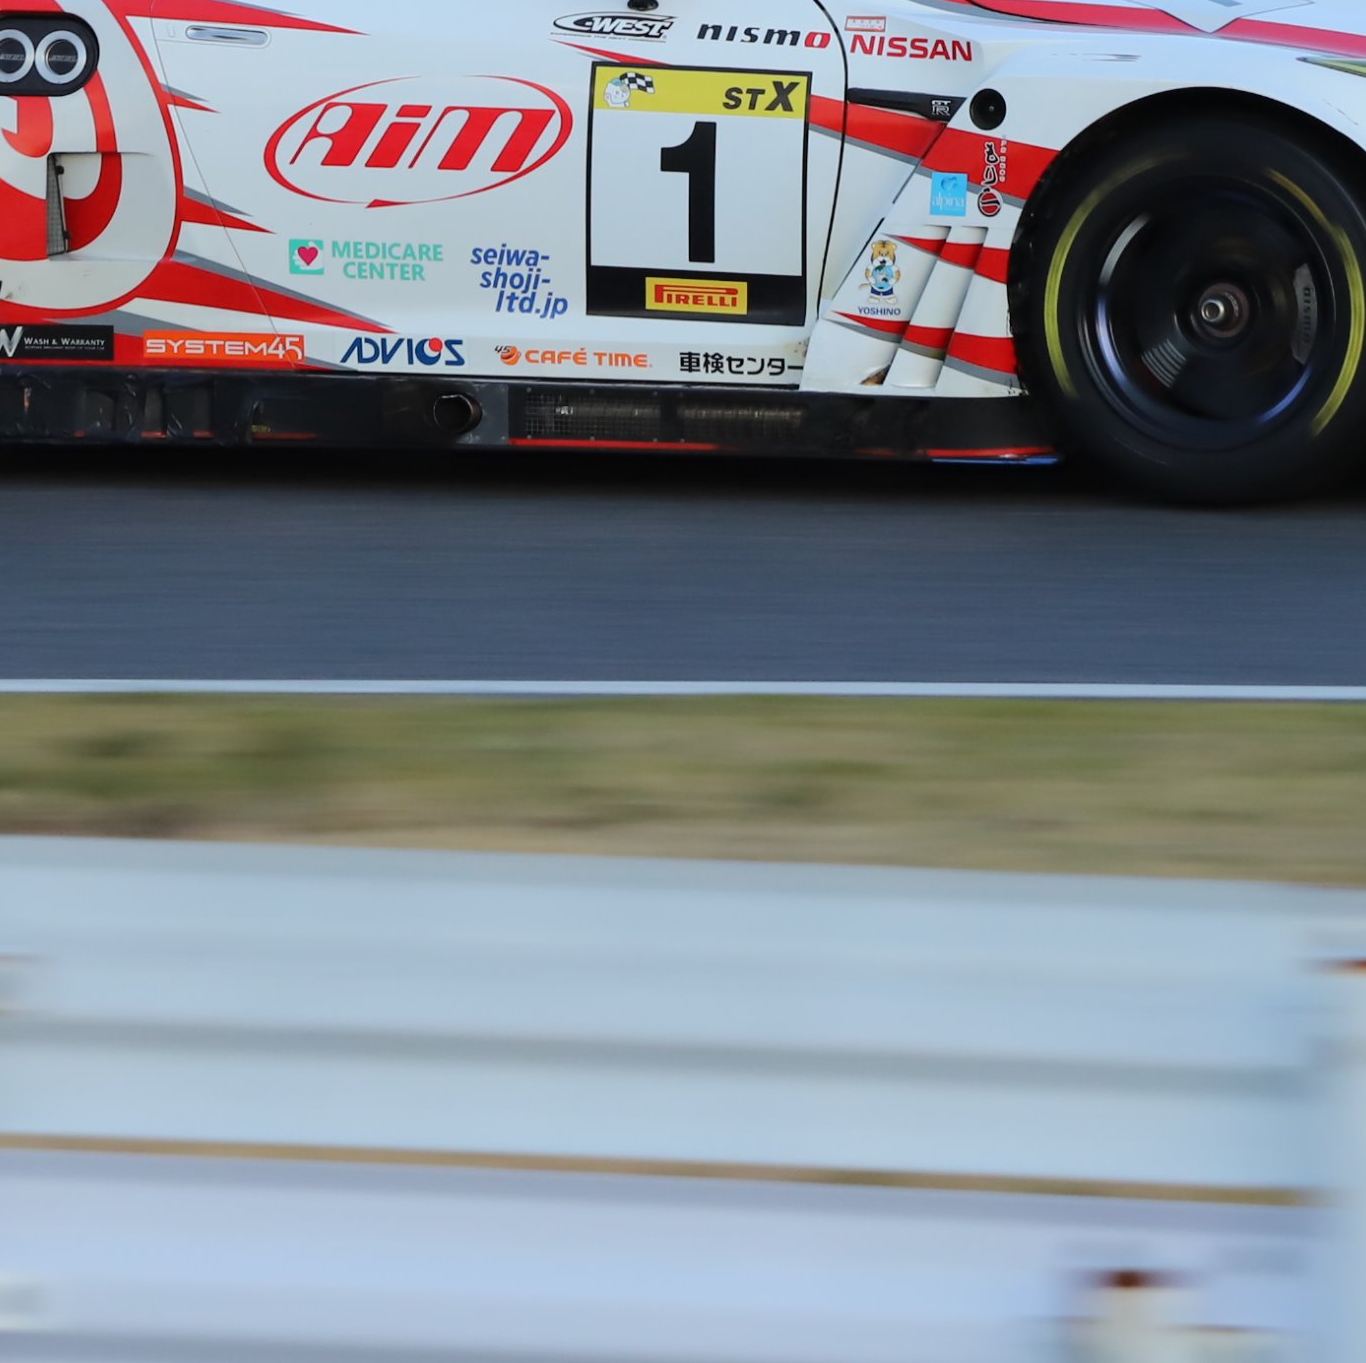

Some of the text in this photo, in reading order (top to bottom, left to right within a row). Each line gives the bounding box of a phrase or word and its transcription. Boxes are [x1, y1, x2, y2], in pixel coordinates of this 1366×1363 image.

[850, 34, 973, 62] NISSAN
[660, 121, 717, 264] 1
[332, 241, 444, 262] MEDICARE
[470, 243, 550, 267] seiwa-
[342, 261, 426, 281] CENTER
[479, 267, 551, 294] shoji-
[496, 291, 568, 318] ltd.jp
[654, 284, 739, 307] PIRELLI
[857, 306, 901, 316] YOSHINO
[340, 336, 465, 366] ADVICS
[679, 351, 804, 376] 車検センター
